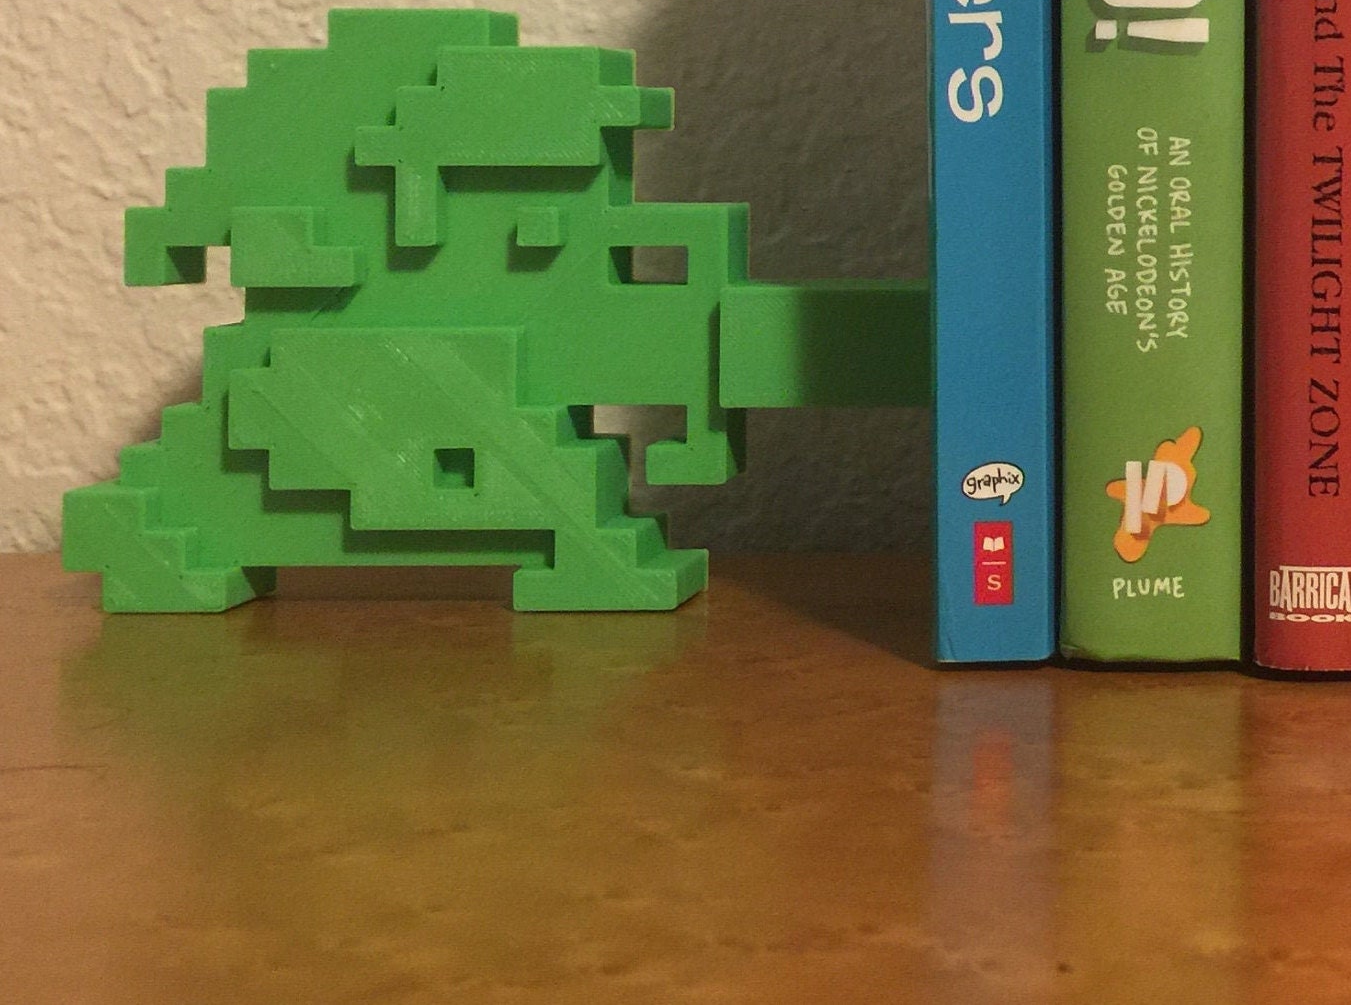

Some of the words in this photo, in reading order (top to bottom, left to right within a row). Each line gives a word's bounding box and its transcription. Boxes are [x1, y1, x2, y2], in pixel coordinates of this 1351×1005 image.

[1312, 56, 1346, 132] The
[1137, 127, 1158, 155] OF
[1169, 136, 1191, 167] AN
[1106, 164, 1127, 256] GOLDEN
[1169, 177, 1192, 234] ORAL
[1136, 165, 1158, 353] NICKELODEON'S
[1309, 146, 1344, 364] TWILIGHT
[1105, 268, 1127, 316] AGE
[1166, 243, 1193, 339] HISTORY
[1308, 379, 1341, 498] ZONE
[966, 467, 1021, 495] graphix
[1113, 577, 1185, 599] PLUME
